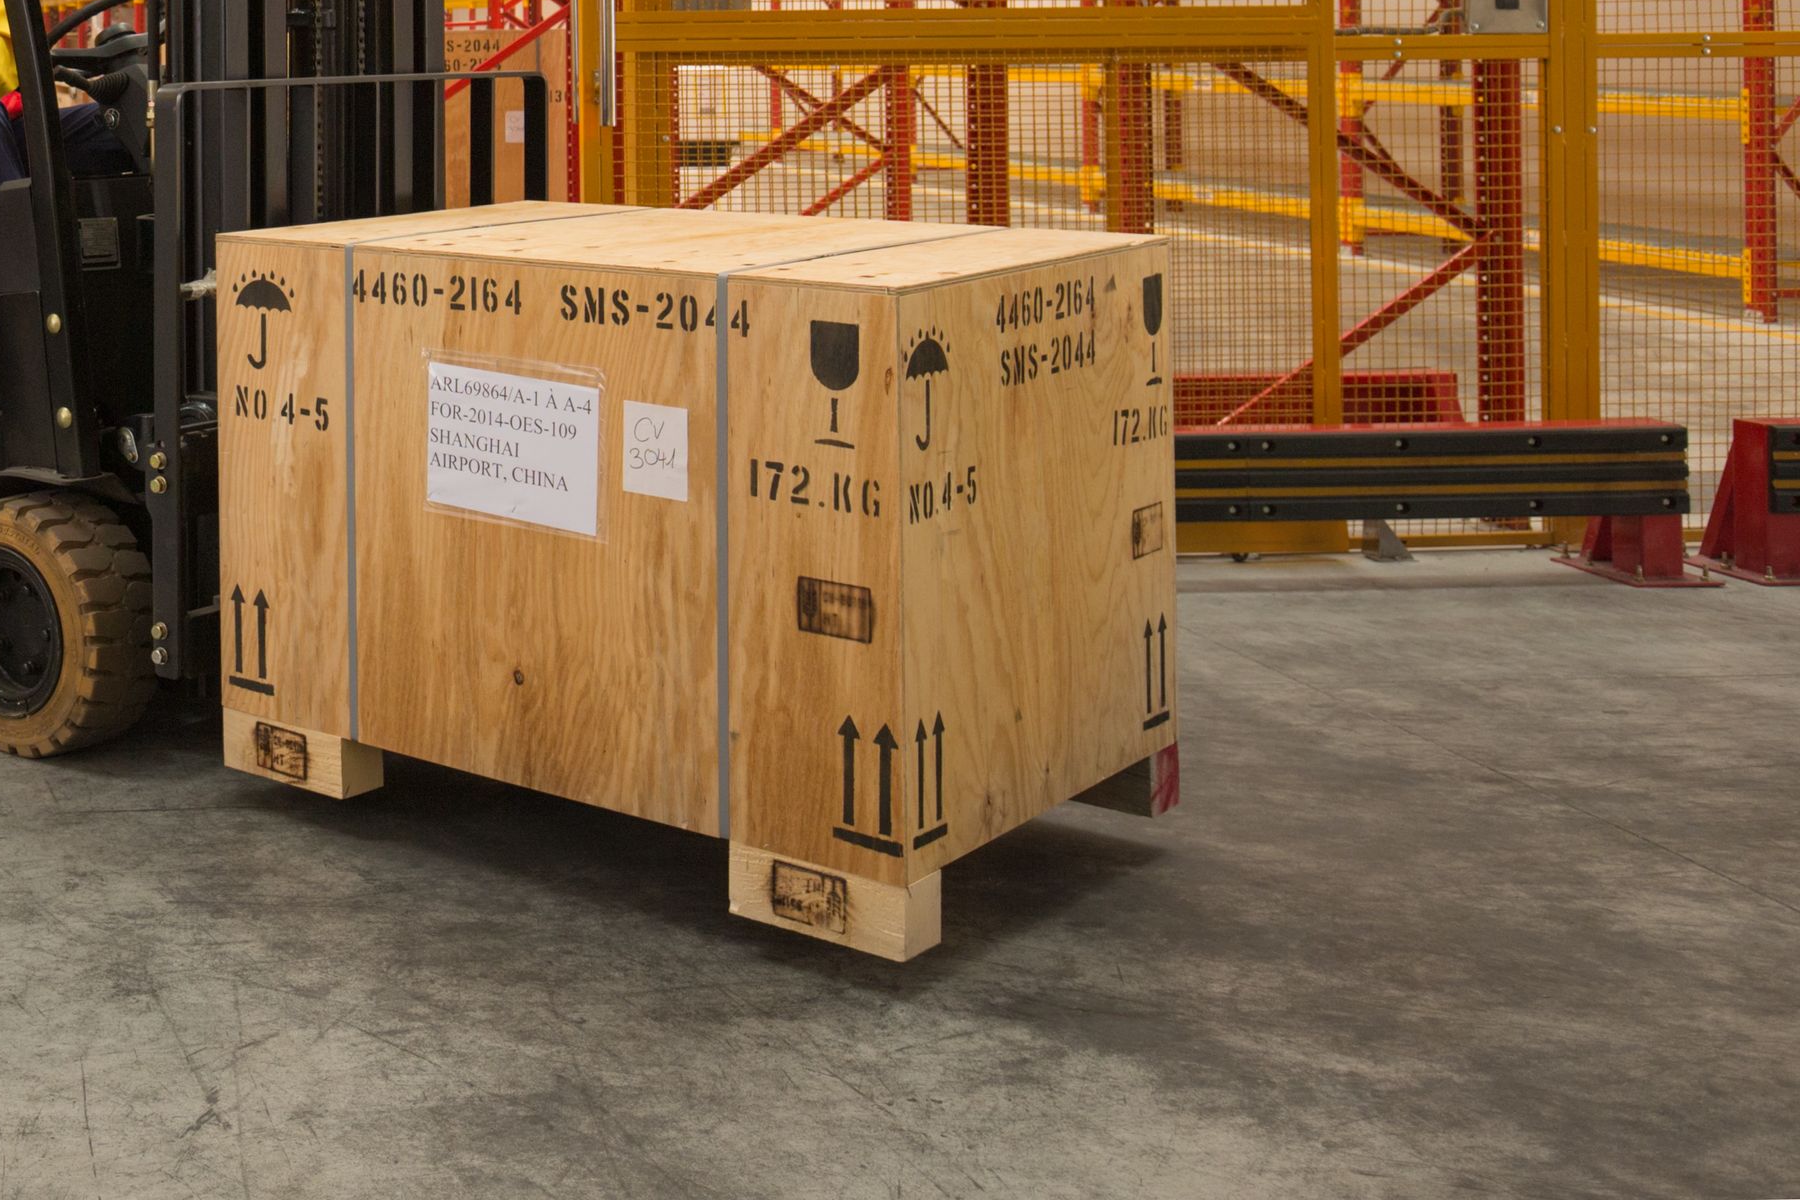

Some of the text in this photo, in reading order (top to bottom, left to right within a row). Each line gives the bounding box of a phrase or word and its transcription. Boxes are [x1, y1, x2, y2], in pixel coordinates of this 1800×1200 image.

[352, 269, 750, 338] 4460-2164 SMS-2044
[996, 275, 1095, 334] 4460-2164
[1001, 329, 1096, 387] SMS-2044
[430, 375, 540, 407] ARL69864/A-1
[563, 397, 592, 415] A-4
[430, 400, 577, 440] FOR-2014-OES-109
[1113, 405, 1168, 446] 172.KG
[430, 427, 520, 458] SHANGHAI
[429, 451, 569, 492] AIRPORT, CHINA
[750, 458, 880, 518] 172.KG
